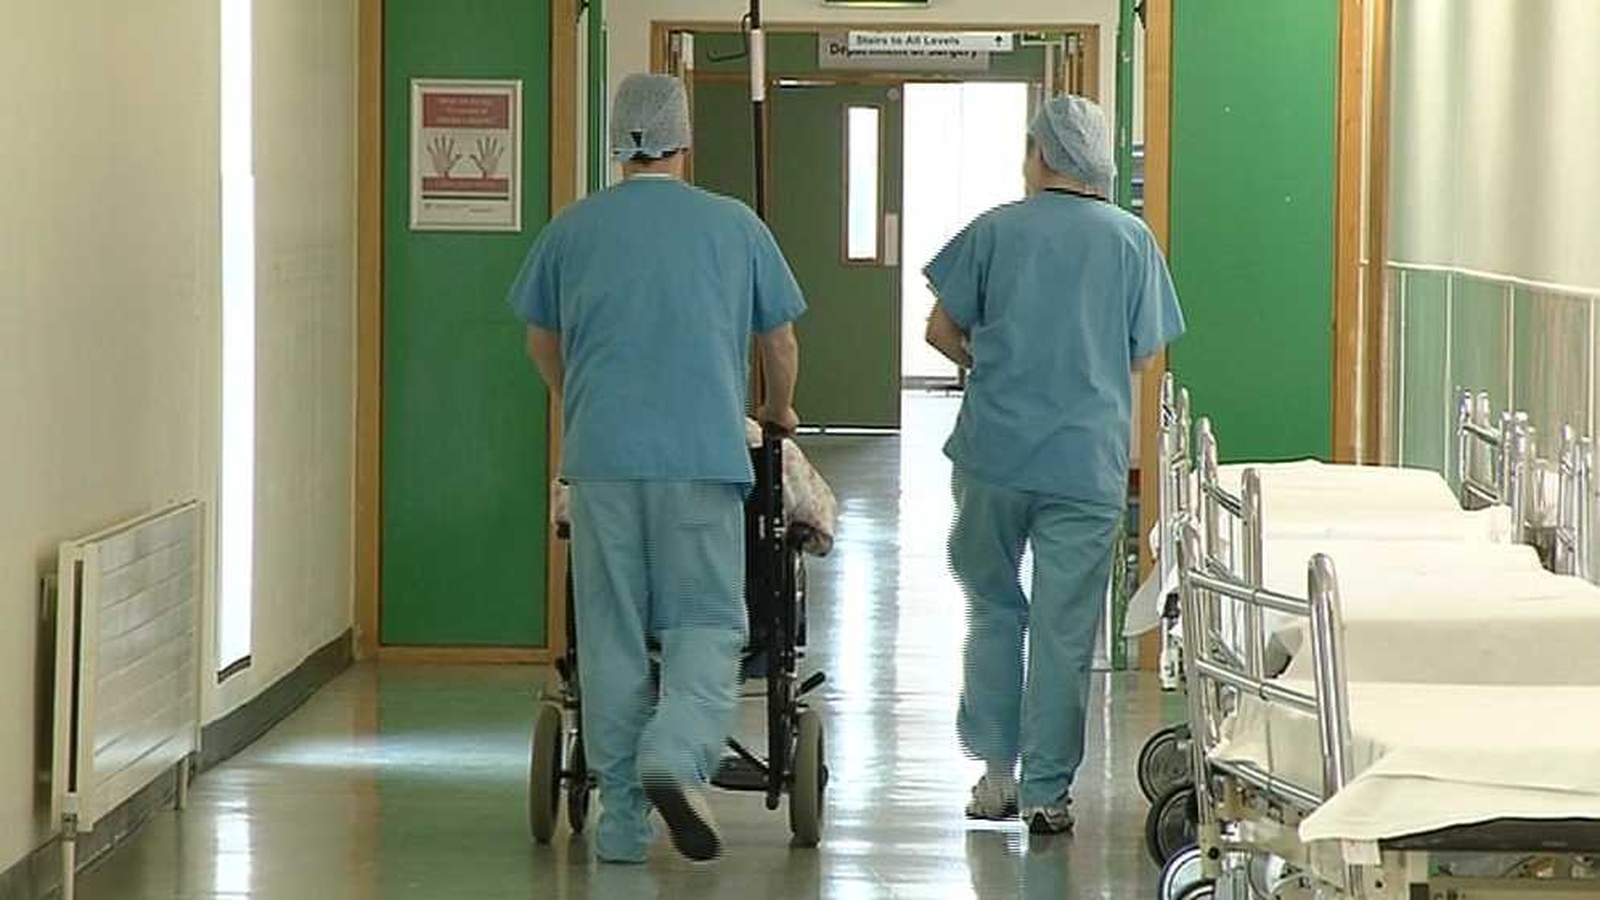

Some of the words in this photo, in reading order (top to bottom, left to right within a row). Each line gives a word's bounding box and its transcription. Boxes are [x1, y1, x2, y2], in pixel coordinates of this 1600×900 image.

[857, 34, 887, 45] Stairs
[890, 35, 902, 45] to
[905, 34, 922, 45] All
[924, 34, 960, 45] Levels
